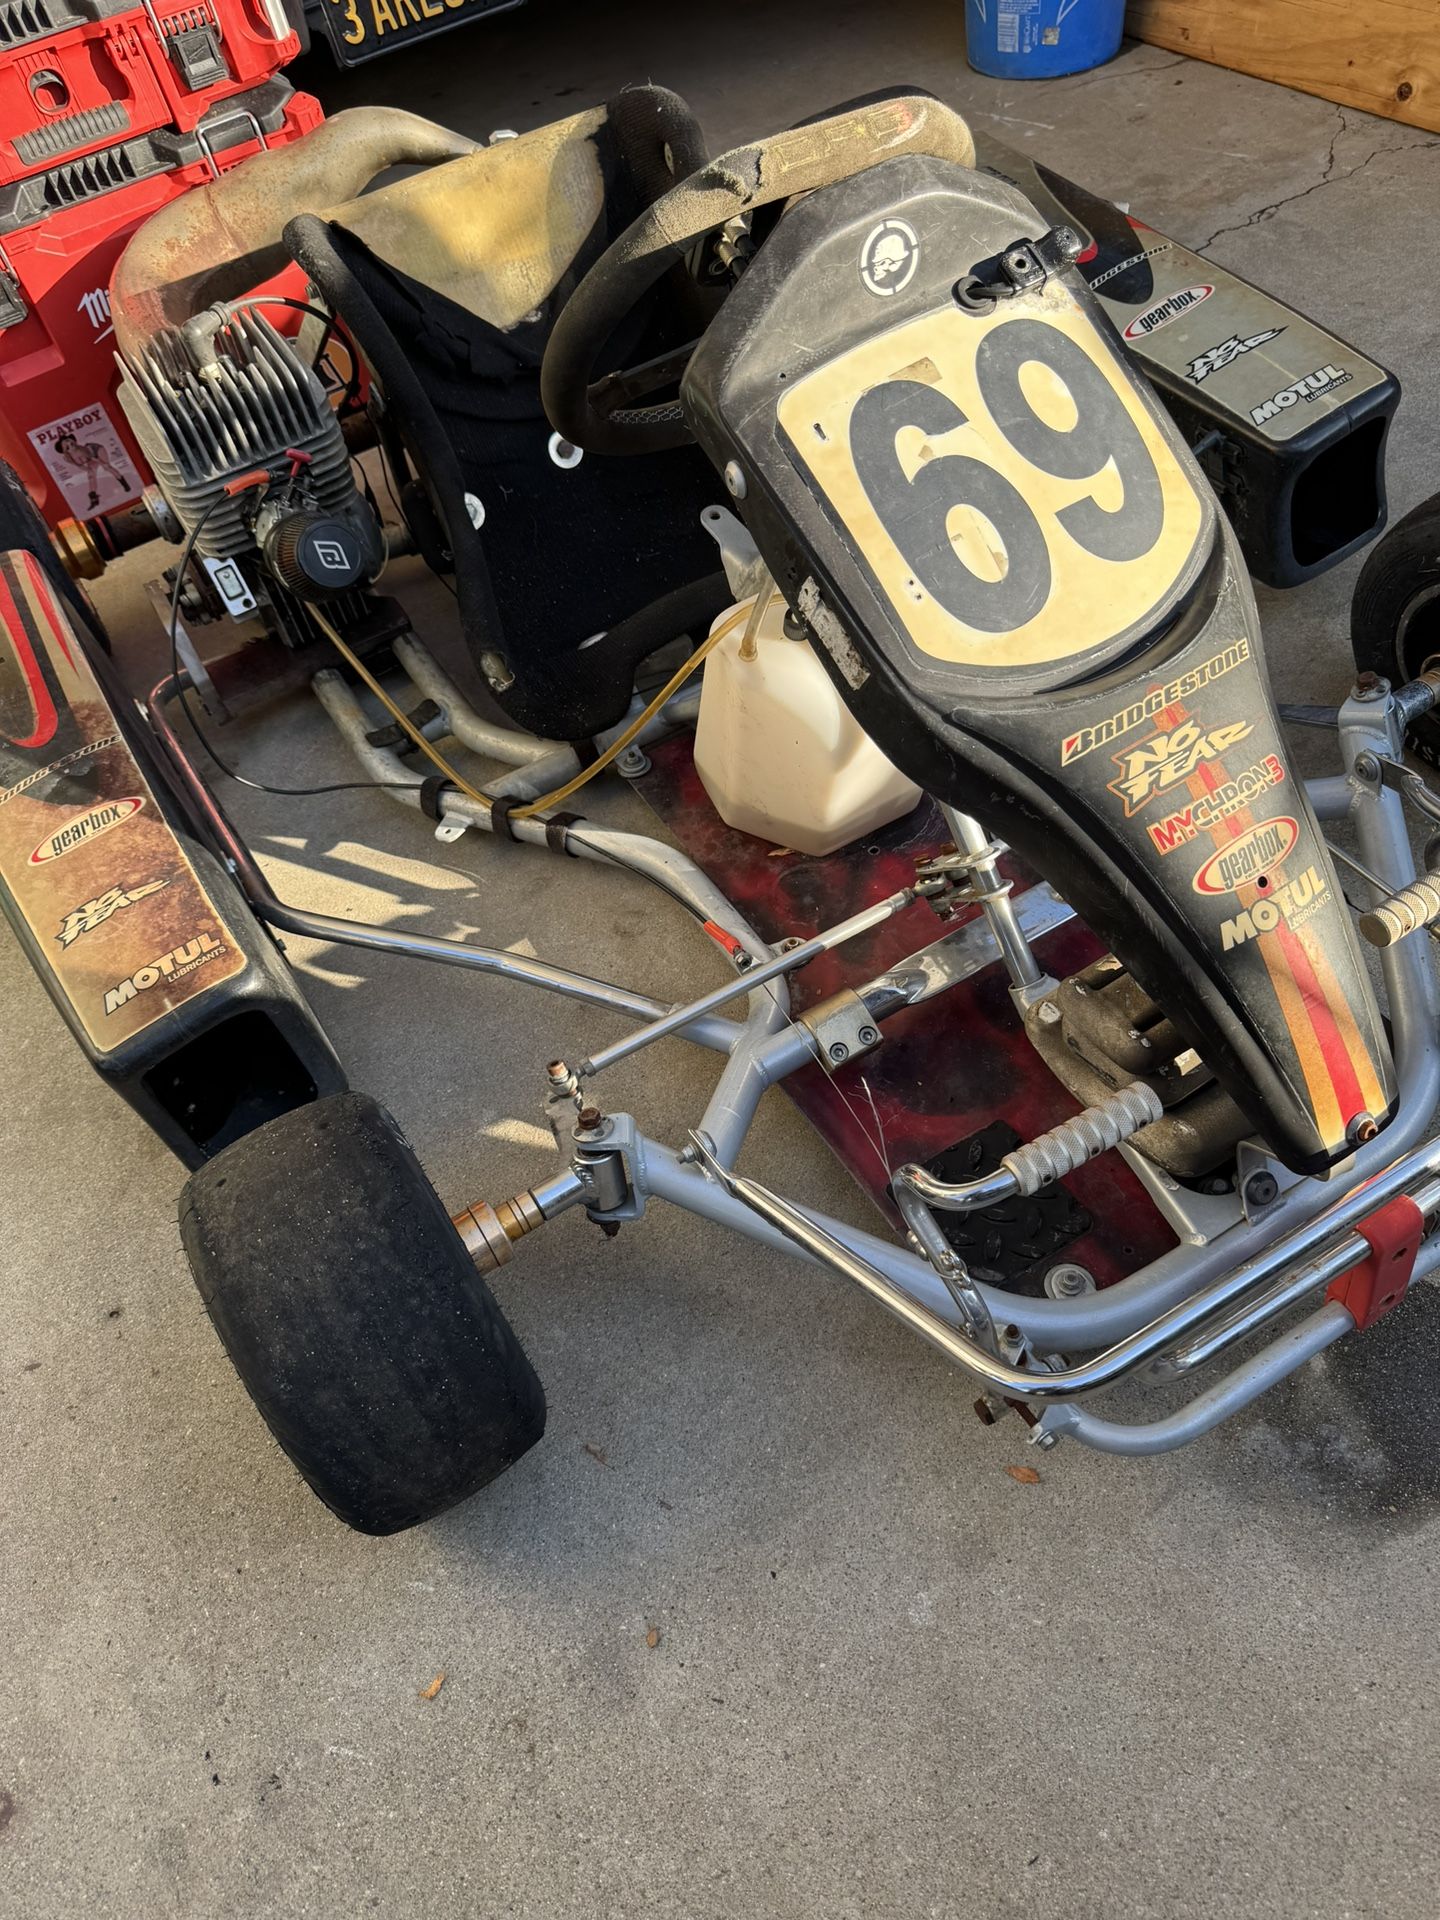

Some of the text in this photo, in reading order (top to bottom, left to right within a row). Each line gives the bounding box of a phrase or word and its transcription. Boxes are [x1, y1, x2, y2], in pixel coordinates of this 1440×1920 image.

[1089, 243, 1174, 290] IDGESTONE
[1138, 290, 1198, 333] gearbox
[1185, 325, 1289, 385] FEAR
[1186, 334, 1241, 372] NO
[1250, 364, 1346, 427] MOTUL
[1305, 373, 1354, 403] LUBRICANTS
[37, 410, 102, 445] PLAYBOY
[848, 318, 1165, 634] 69
[1061, 637, 1250, 768] BRIDGESTONE
[0, 734, 122, 805] RIDGESTONE
[1119, 720, 1255, 804] FEAR
[1124, 720, 1201, 780] NO
[51, 804, 122, 858] gearbox
[1218, 824, 1285, 890] gearbox
[54, 879, 172, 951] FEAR
[60, 882, 123, 931] NO
[1220, 865, 1326, 952] MOTUL
[103, 932, 222, 1017] MOTUL
[167, 945, 227, 984] LUBRICANTS
